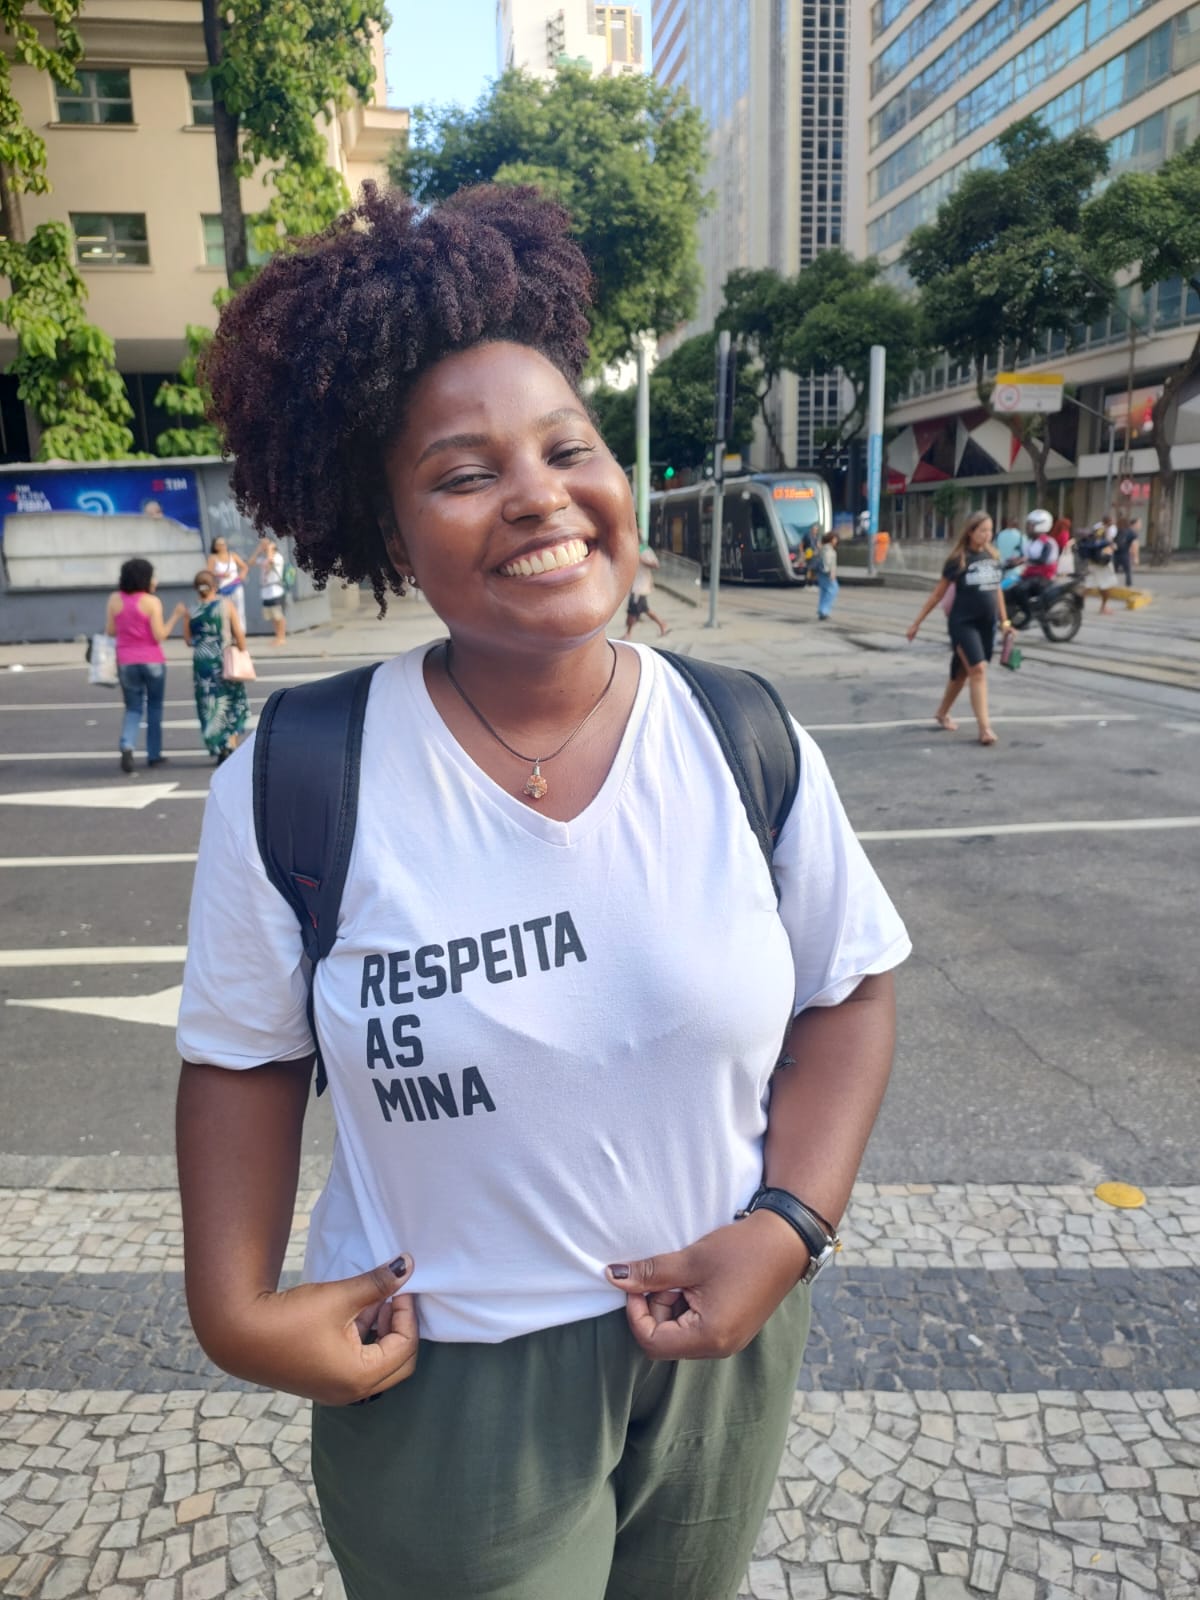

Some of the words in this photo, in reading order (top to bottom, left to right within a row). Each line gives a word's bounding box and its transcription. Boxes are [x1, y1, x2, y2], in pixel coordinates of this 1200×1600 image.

[165, 478, 187, 490] TIM
[361, 911, 587, 1008] RESPEITA
[366, 1014, 424, 1069] AS
[372, 1066, 496, 1122] MINA
